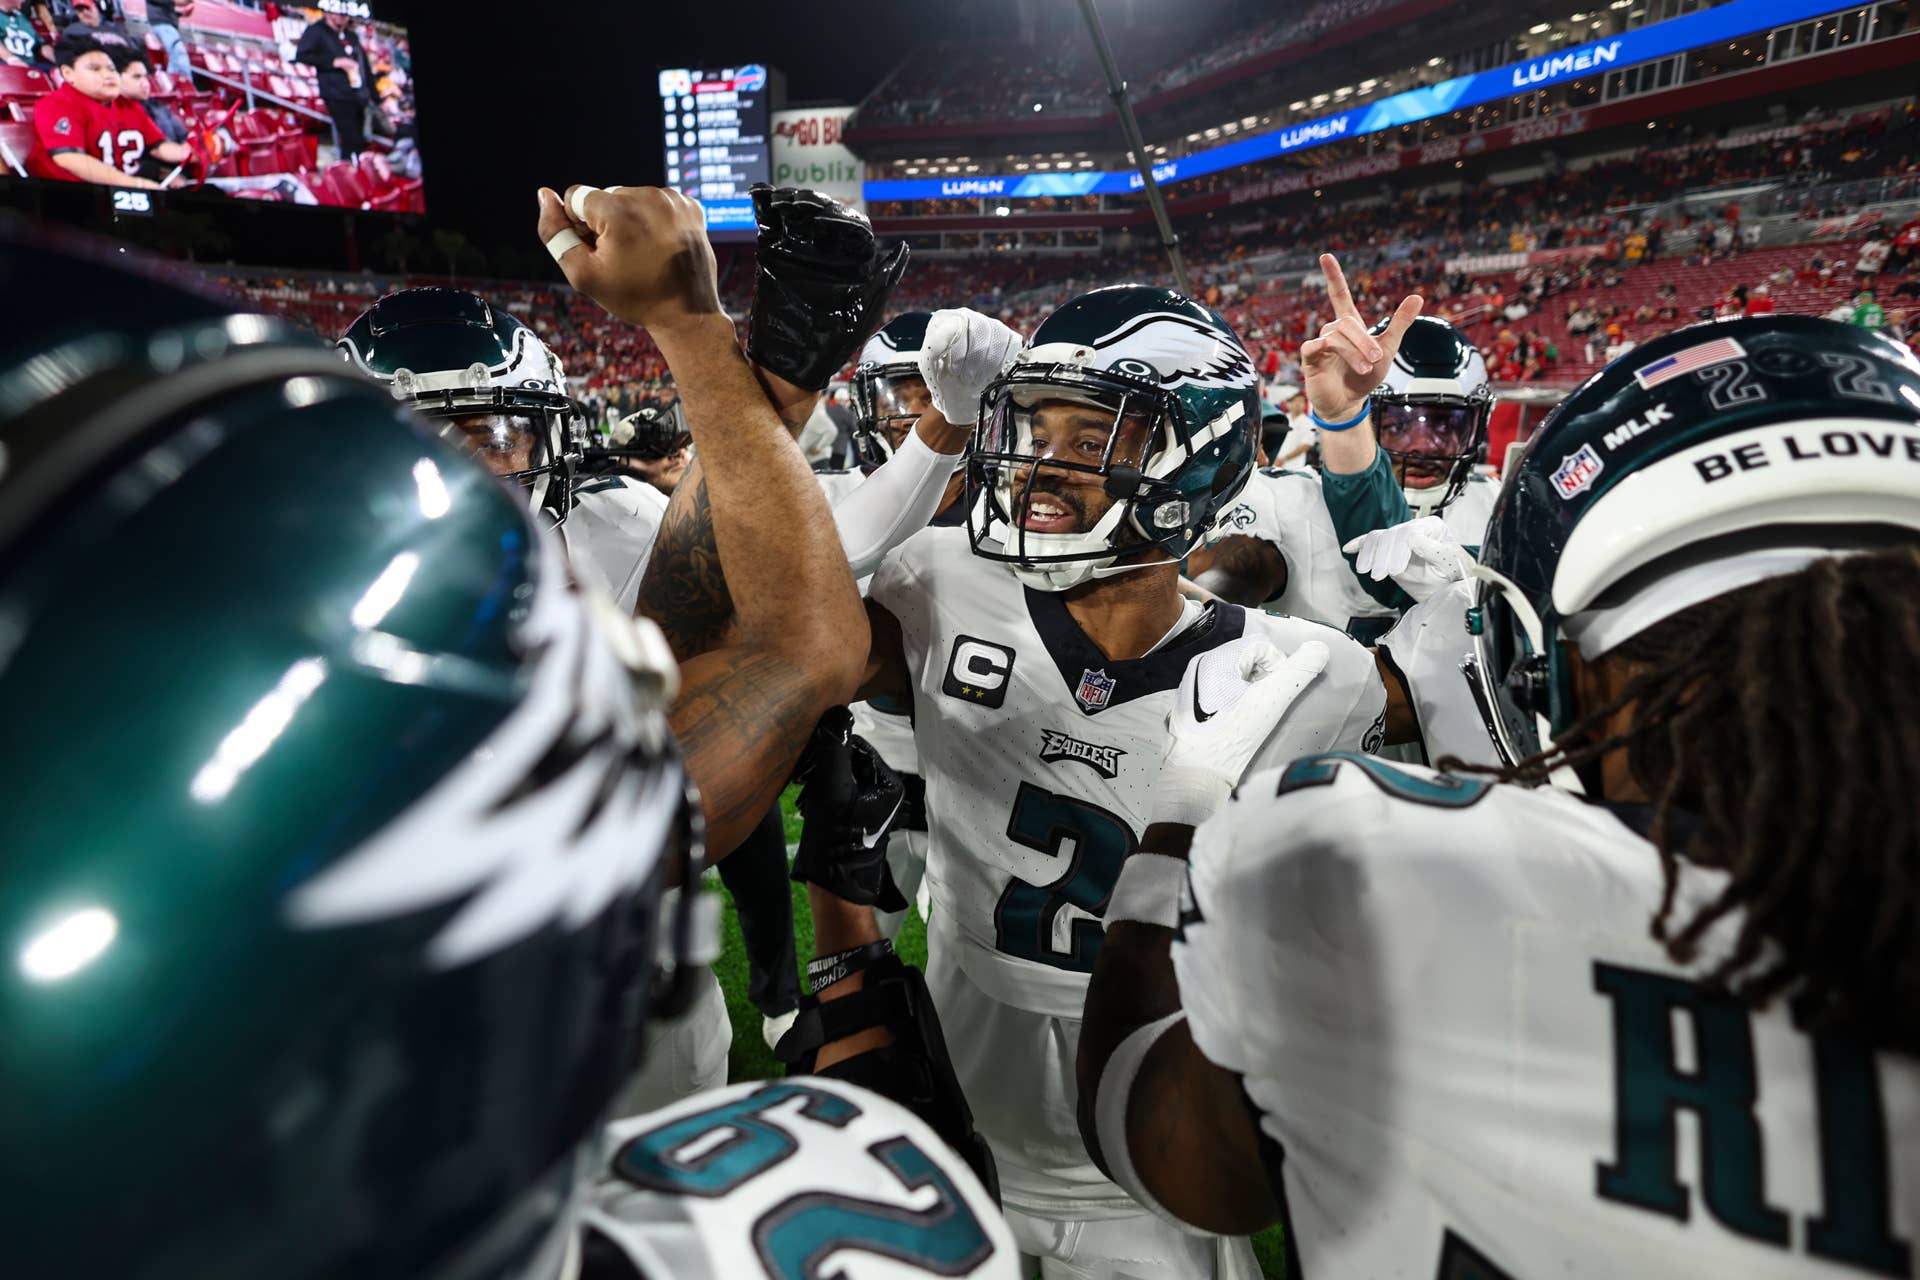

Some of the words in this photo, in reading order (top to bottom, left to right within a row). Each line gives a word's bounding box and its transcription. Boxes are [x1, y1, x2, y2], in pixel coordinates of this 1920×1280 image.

[1513, 41, 1621, 88] LUMEN
[98, 130, 145, 175] 12
[799, 117, 818, 146] GO
[1280, 116, 1348, 149] LUMEN
[1312, 152, 1400, 187] CHAMPIONS
[1511, 118, 1559, 145] 2020
[777, 161, 857, 184] Publix
[942, 180, 1004, 195] LUMEN
[1603, 402, 1674, 451] MLK
[1562, 461, 1597, 492] NFL
[1693, 442, 1770, 484] BE
[1781, 431, 1920, 463] LOVE
[952, 641, 1009, 690] C
[1082, 683, 1105, 704] NFL
[1040, 729, 1126, 775] EAGLES
[994, 780, 1140, 974] 2
